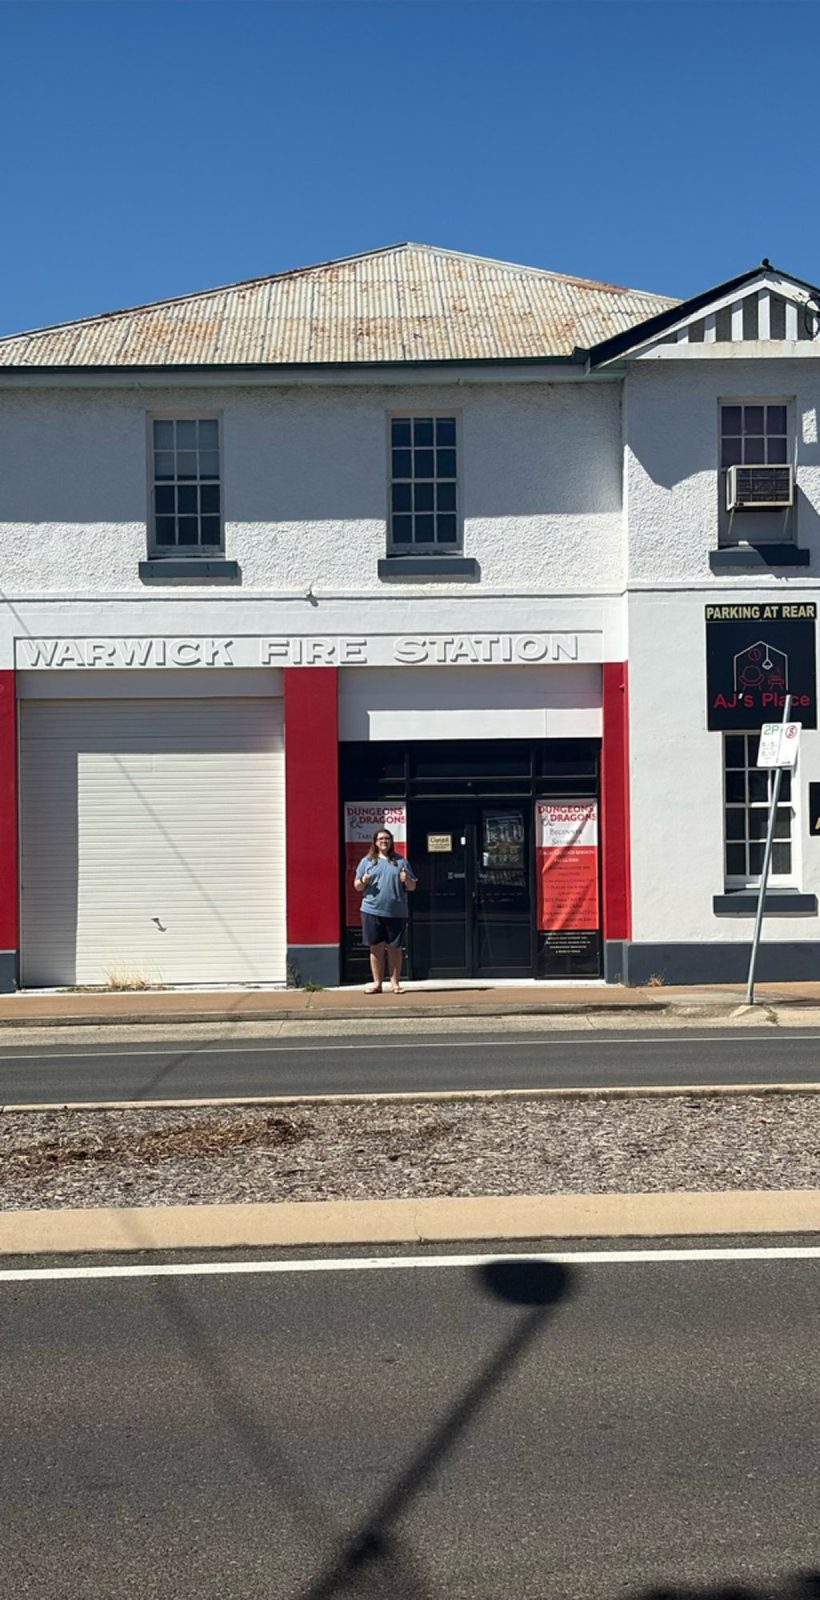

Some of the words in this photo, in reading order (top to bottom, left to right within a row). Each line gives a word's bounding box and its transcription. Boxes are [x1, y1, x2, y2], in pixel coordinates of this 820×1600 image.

[706, 606, 760, 619] PARKING
[763, 606, 779, 618] AT
[782, 605, 815, 618] REAR
[21, 639, 234, 667] WARWICK
[260, 637, 368, 665] FIRE
[393, 634, 578, 664] STATION
[713, 693, 754, 708] AJ's
[762, 692, 811, 707] Place
[763, 724, 780, 735] 2P
[347, 807, 403, 816] DUNGEONS
[538, 805, 594, 814] DUNGEONS
[359, 815, 405, 824] DRAGONS
[550, 813, 596, 822] DRAGONS
